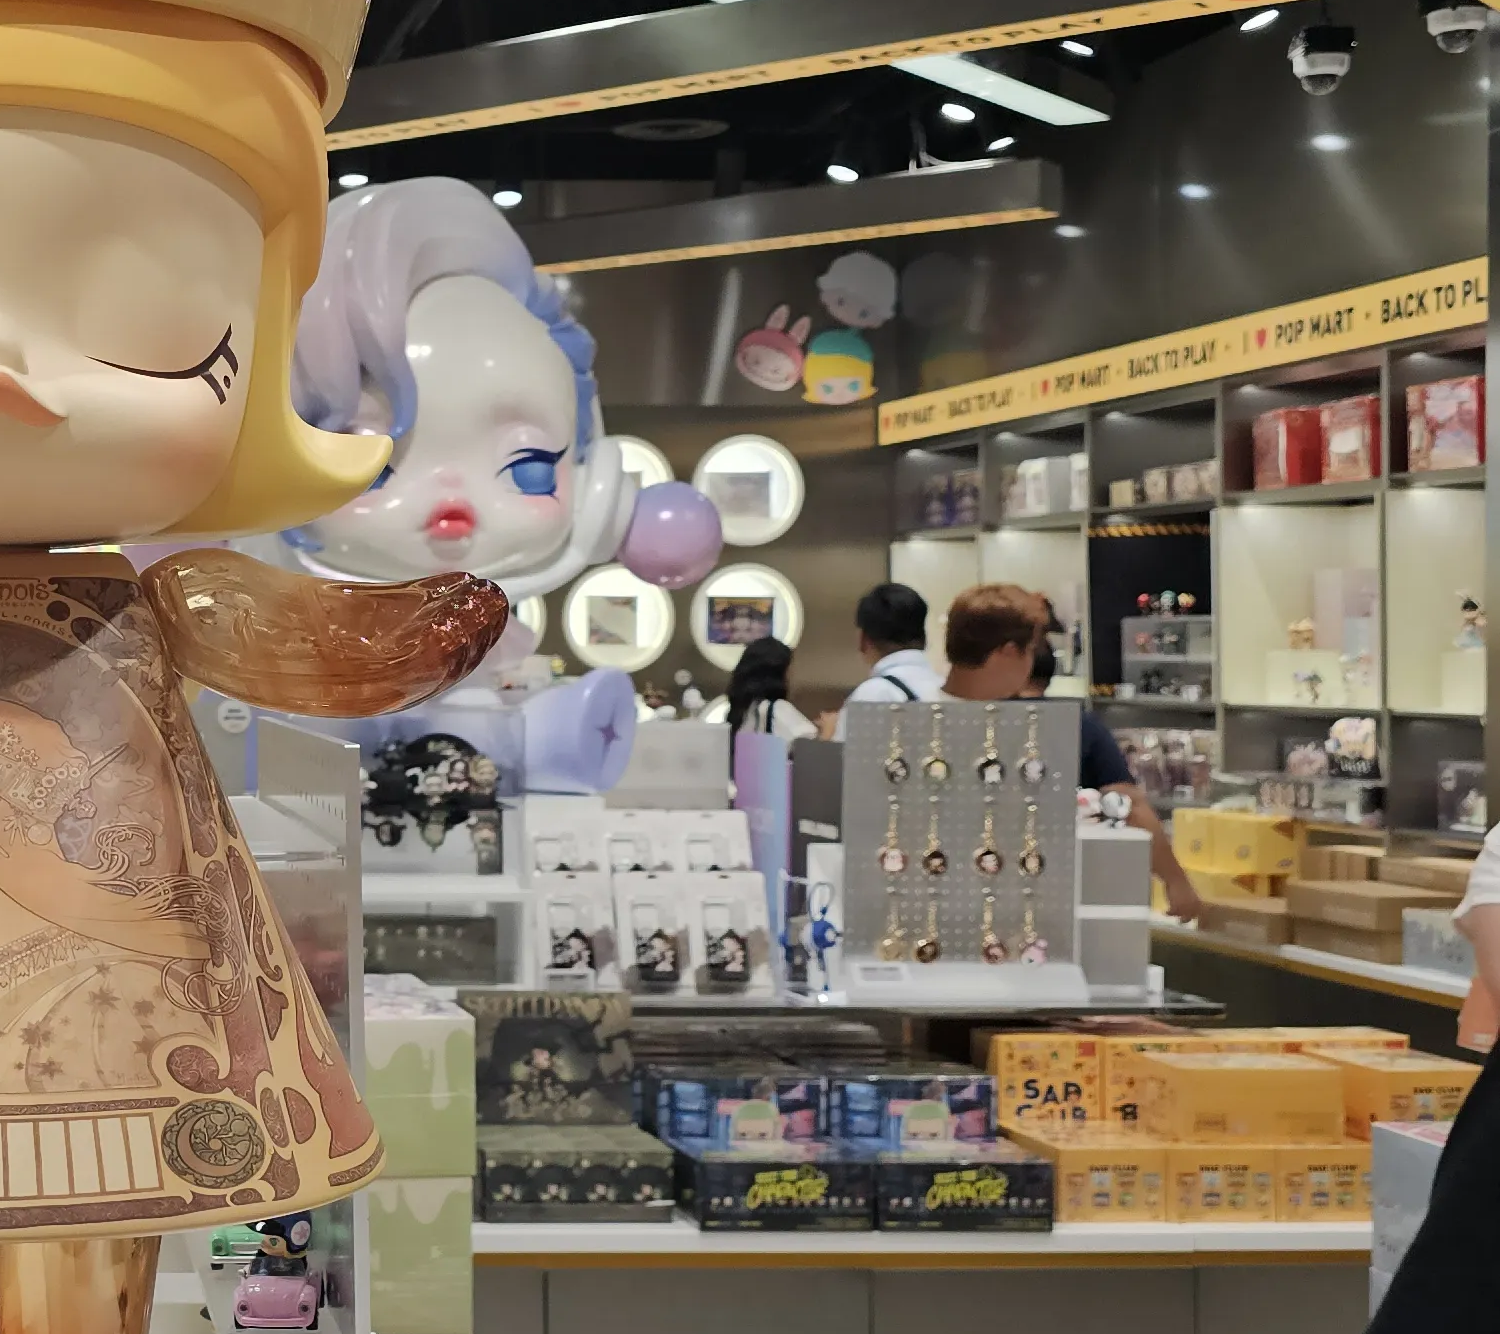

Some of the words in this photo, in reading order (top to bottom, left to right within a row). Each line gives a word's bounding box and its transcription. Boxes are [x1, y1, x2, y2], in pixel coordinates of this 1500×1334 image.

[1003, 16, 1107, 41] PLAY
[1127, 351, 1160, 379] BACK
[1181, 340, 1218, 368] PLAY
[1273, 318, 1305, 349] POP
[1308, 305, 1356, 339] MART
[1379, 286, 1430, 325] BACK
[1432, 283, 1458, 311] TO
[1461, 276, 1489, 308] PL
